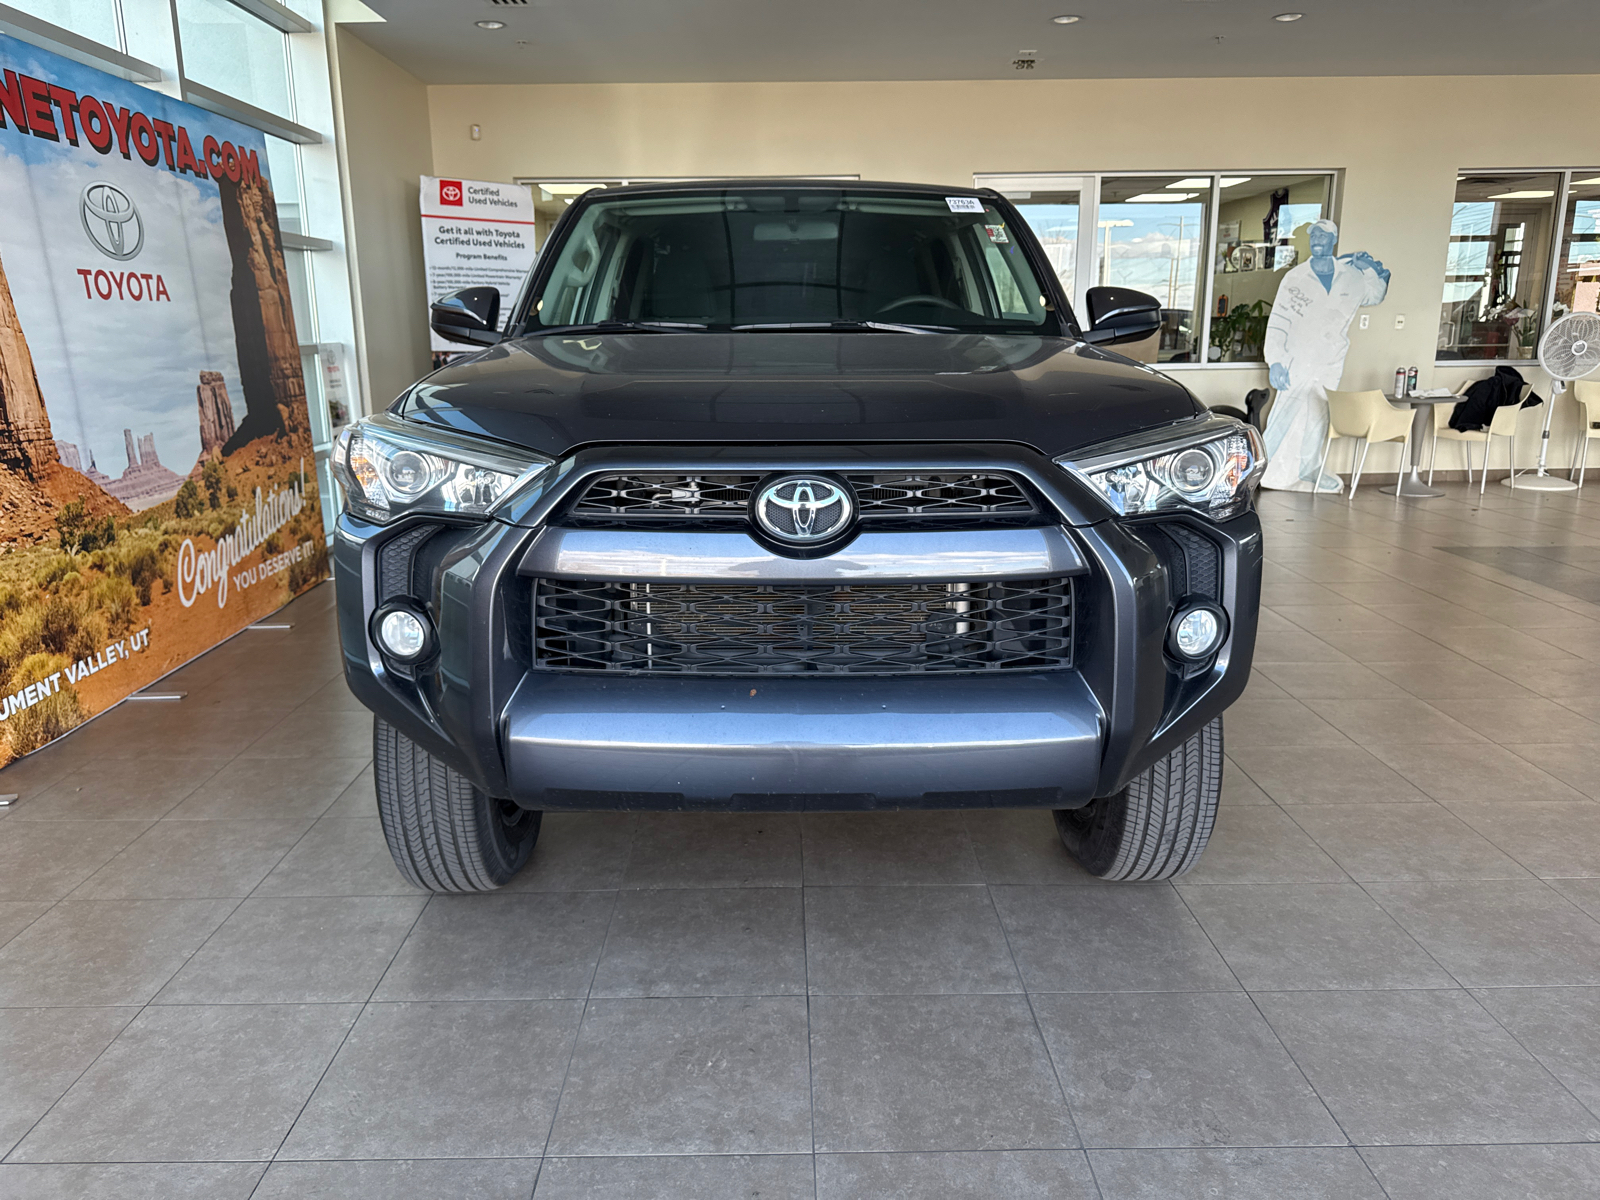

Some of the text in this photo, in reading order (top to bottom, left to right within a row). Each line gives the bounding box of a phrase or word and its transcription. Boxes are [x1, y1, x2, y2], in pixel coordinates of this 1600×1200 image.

[0, 68, 262, 188] NETOYOTA.COM
[467, 186, 500, 197] Certified
[468, 197, 518, 208] Used Vehicles
[434, 236, 525, 249] Certified Used Vehicles
[438, 226, 520, 239] Get it all with Toyota
[455, 252, 508, 261] Program Benefits
[77, 268, 171, 302] TOYOTA
[177, 457, 306, 609] Congratulations!
[233, 540, 315, 592] YOU DESERVE IT!
[64, 639, 129, 685] VALLEY,
[130, 628, 149, 652] UT
